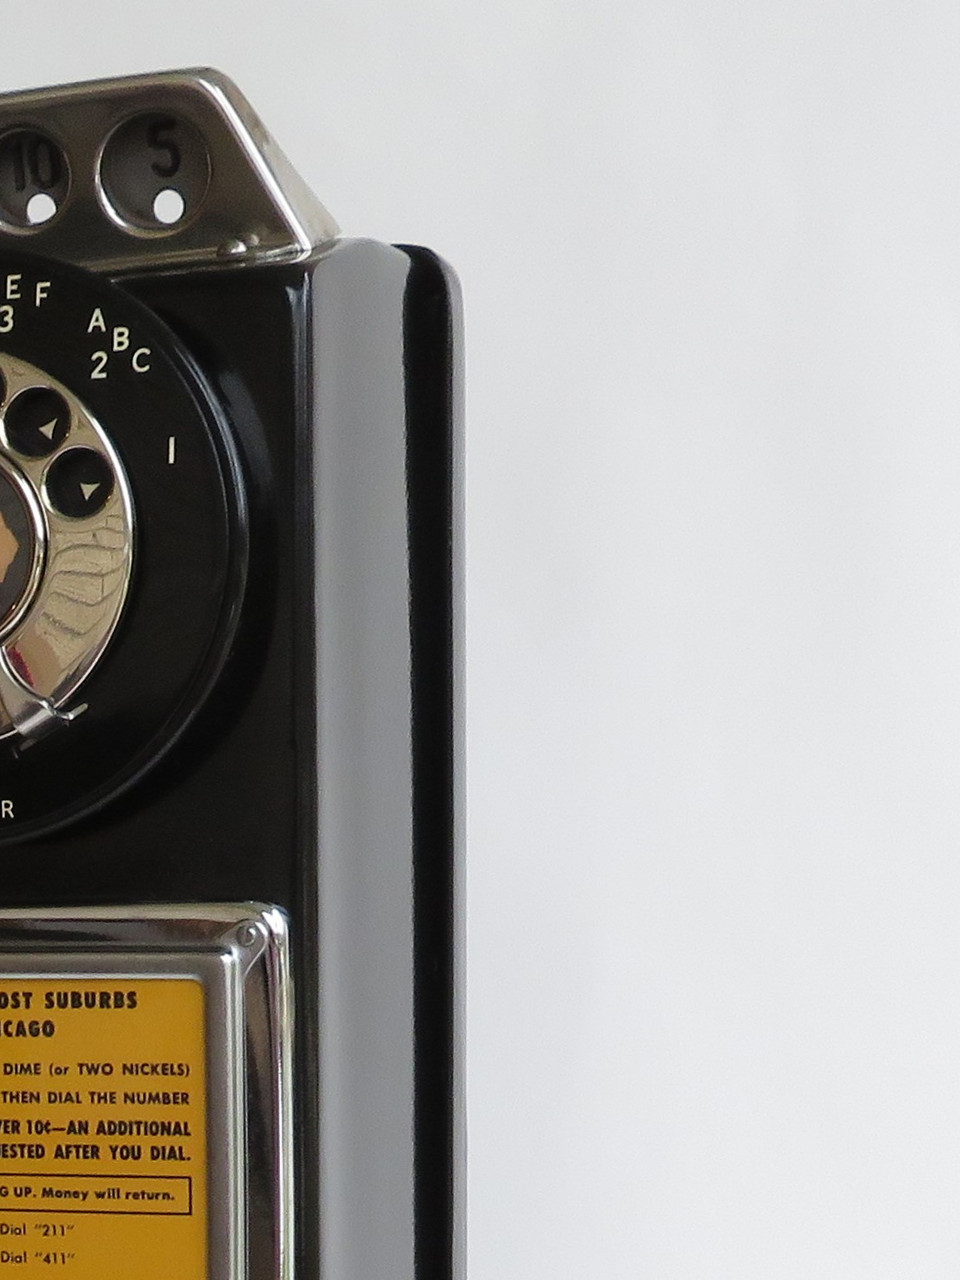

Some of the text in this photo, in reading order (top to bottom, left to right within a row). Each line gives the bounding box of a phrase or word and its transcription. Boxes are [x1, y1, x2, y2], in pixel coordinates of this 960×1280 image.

[146, 117, 181, 178] 5
[14, 139, 56, 192] 10
[90, 352, 108, 379] 2
[44, 990, 138, 1010] SUBURBS
[3, 1062, 41, 1076] DIME
[49, 1062, 70, 1077] (or
[77, 1062, 114, 1076] TWO
[122, 1062, 190, 1078] NICKELS)
[0, 1090, 41, 1104] THEN
[47, 1091, 83, 1105] DIAL
[88, 1090, 117, 1105] THE
[123, 1091, 190, 1106] NUMBER
[95, 1119, 192, 1137] ADDITIONAL
[53, 1143, 100, 1160] AFTER
[108, 1144, 142, 1161] YOU
[150, 1145, 192, 1162] DIAL.
[13, 1186, 37, 1198] UP.
[41, 1186, 89, 1202] Money
[94, 1187, 121, 1200] will
[124, 1189, 175, 1201] return.
[0, 1222, 27, 1236] Dial
[0, 1250, 27, 1264] Dial
